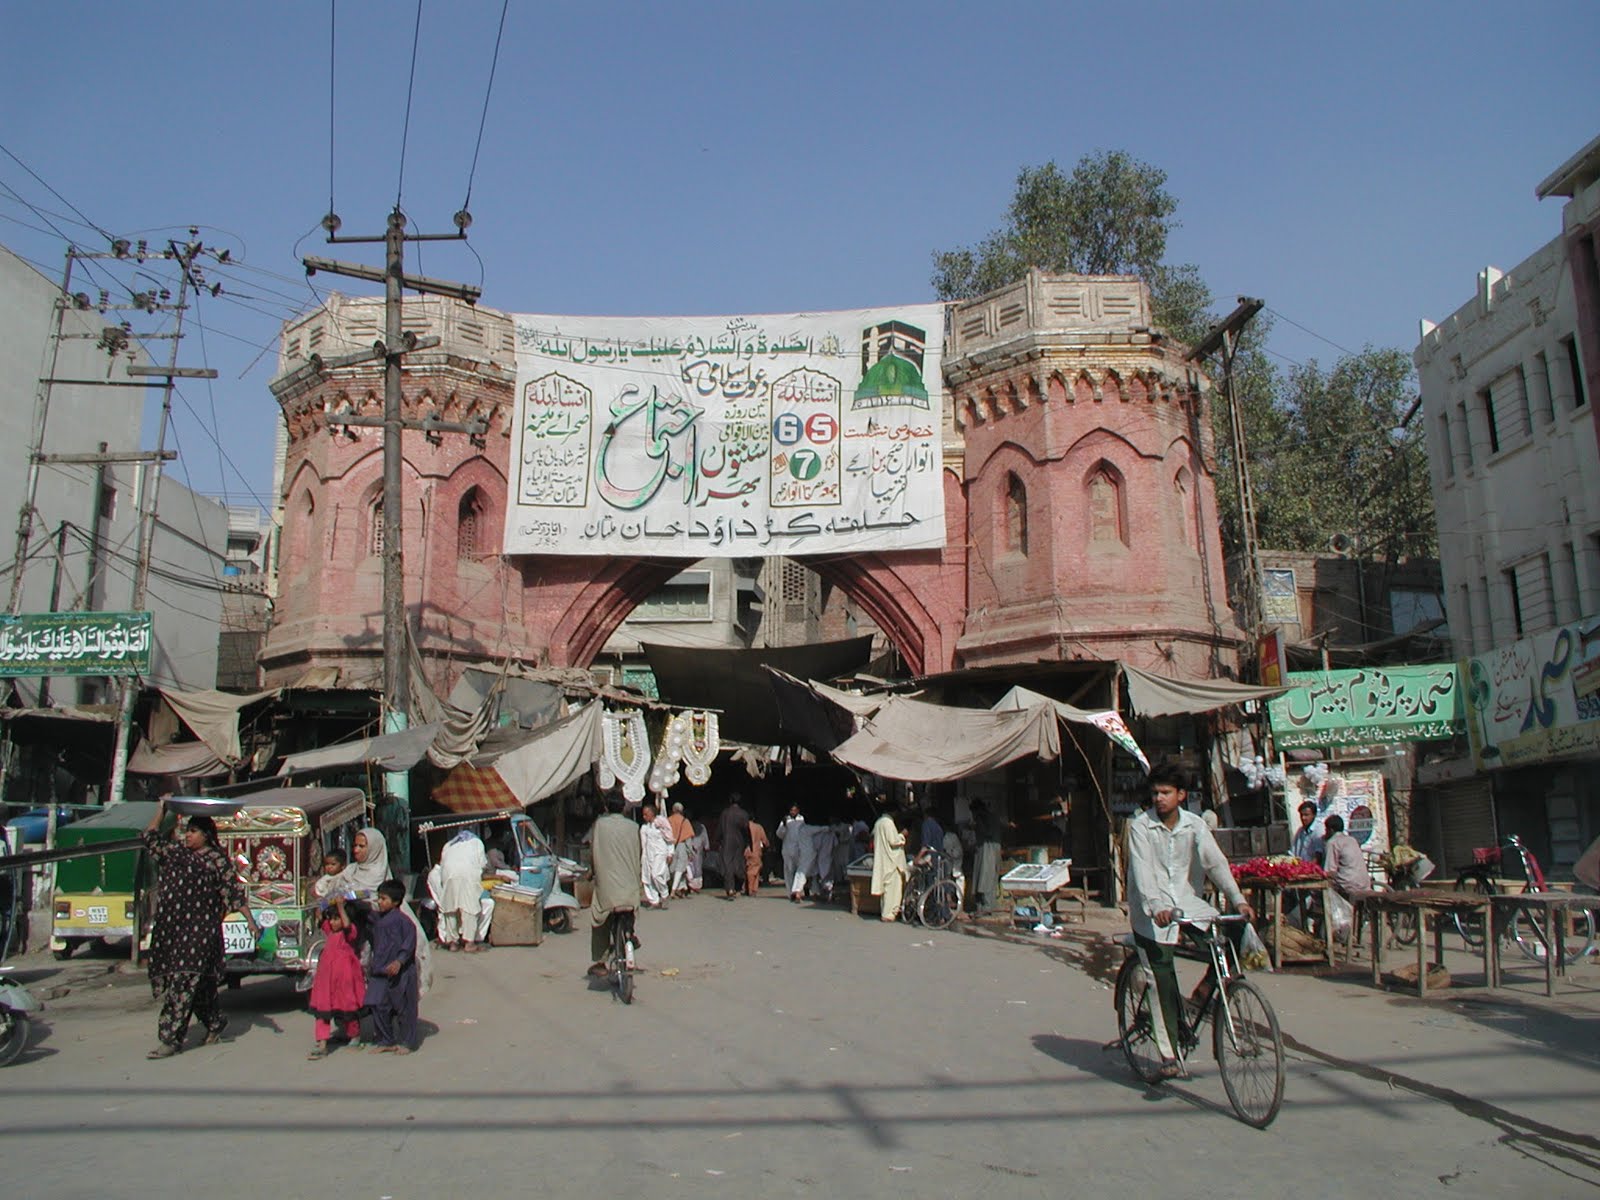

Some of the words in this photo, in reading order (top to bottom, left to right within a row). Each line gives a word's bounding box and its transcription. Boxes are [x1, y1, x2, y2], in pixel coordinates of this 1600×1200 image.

[697, 361, 751, 396] اسلامی
[724, 403, 748, 420] روزہ
[748, 403, 767, 418] تین
[718, 421, 753, 443] الاقوامی
[752, 423, 770, 441] بین
[778, 416, 799, 442] 6
[811, 416, 832, 442] 5
[843, 422, 889, 438] نشست
[888, 424, 935, 441] خصوصی
[593, 382, 706, 513] اجتماع
[886, 442, 904, 476] صبح
[905, 442, 934, 473] اتوار
[794, 452, 816, 479] 7
[845, 452, 871, 478] بجے
[525, 484, 554, 502] شریف
[554, 486, 578, 503] ملتان
[695, 474, 762, 508] بھرا
[620, 515, 686, 540] خان
[1287, 675, 1349, 727] پیلس
[1350, 670, 1412, 720] پرفیوم
[1405, 669, 1455, 718] صمد
